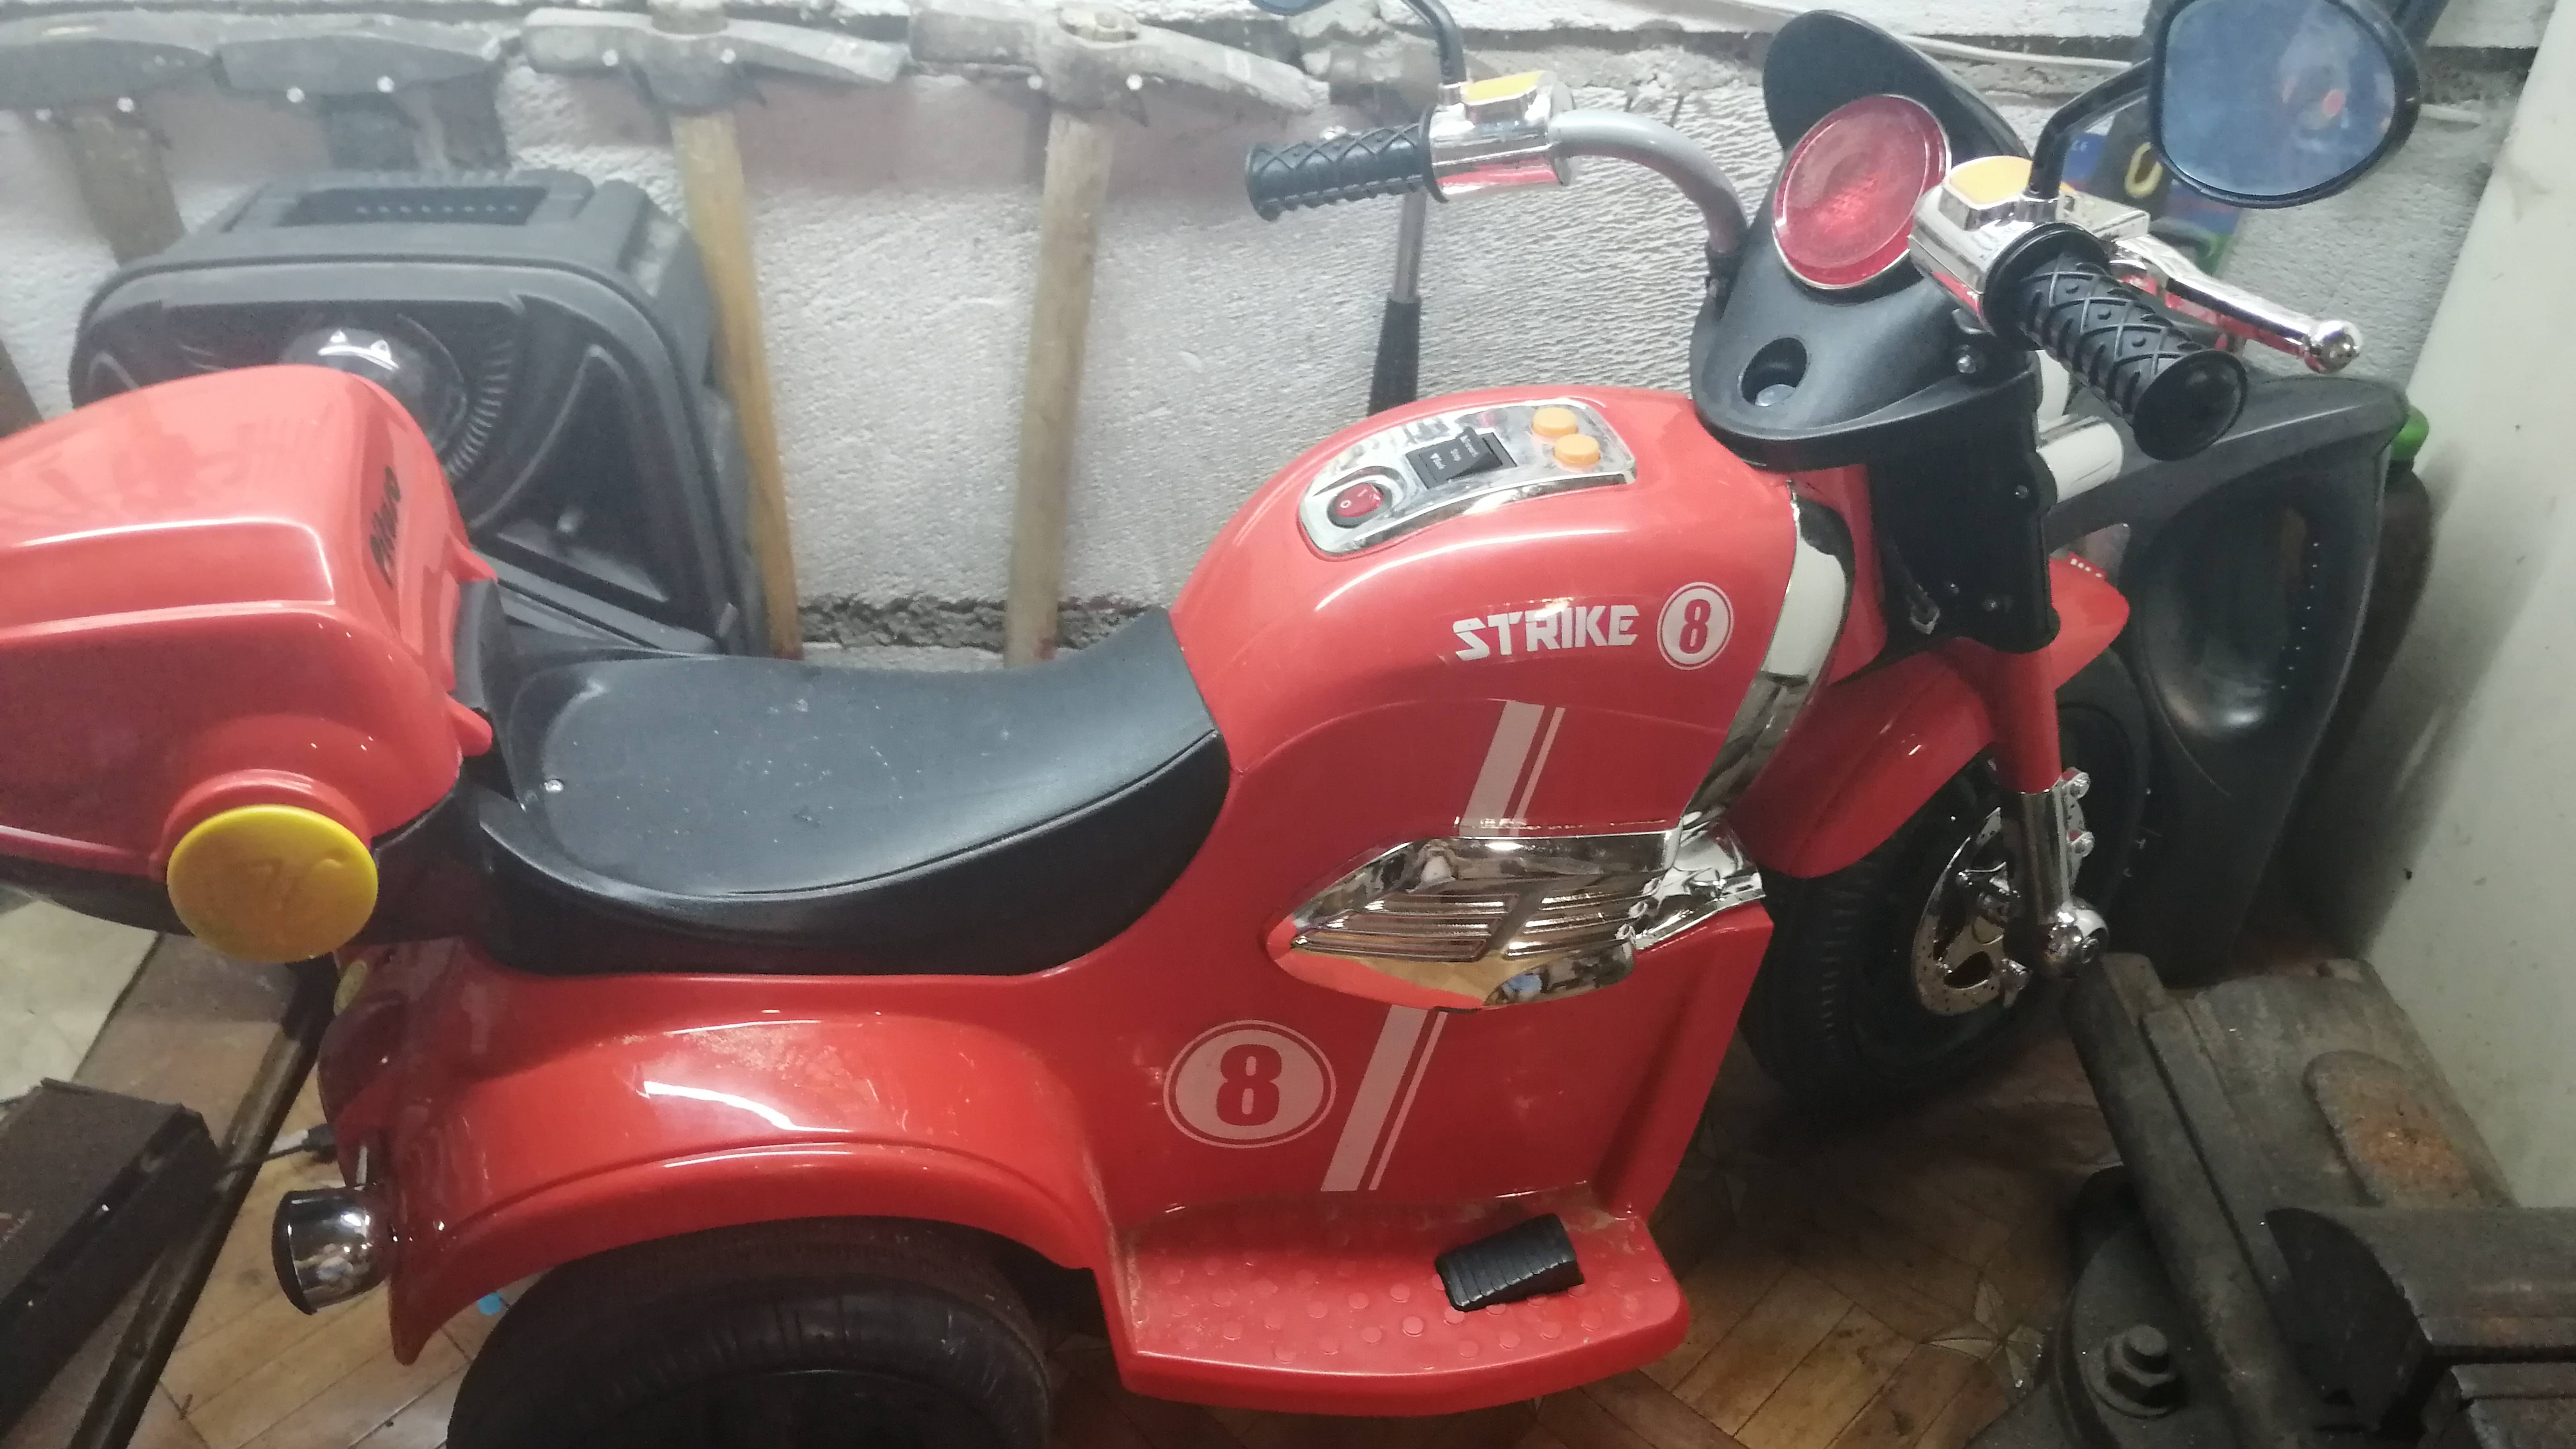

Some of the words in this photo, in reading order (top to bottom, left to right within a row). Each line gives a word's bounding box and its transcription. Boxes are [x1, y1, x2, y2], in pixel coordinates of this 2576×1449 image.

[1453, 605, 1639, 661] STRIKE
[1679, 599, 1712, 653] 8
[1217, 1044, 1282, 1126] 8
